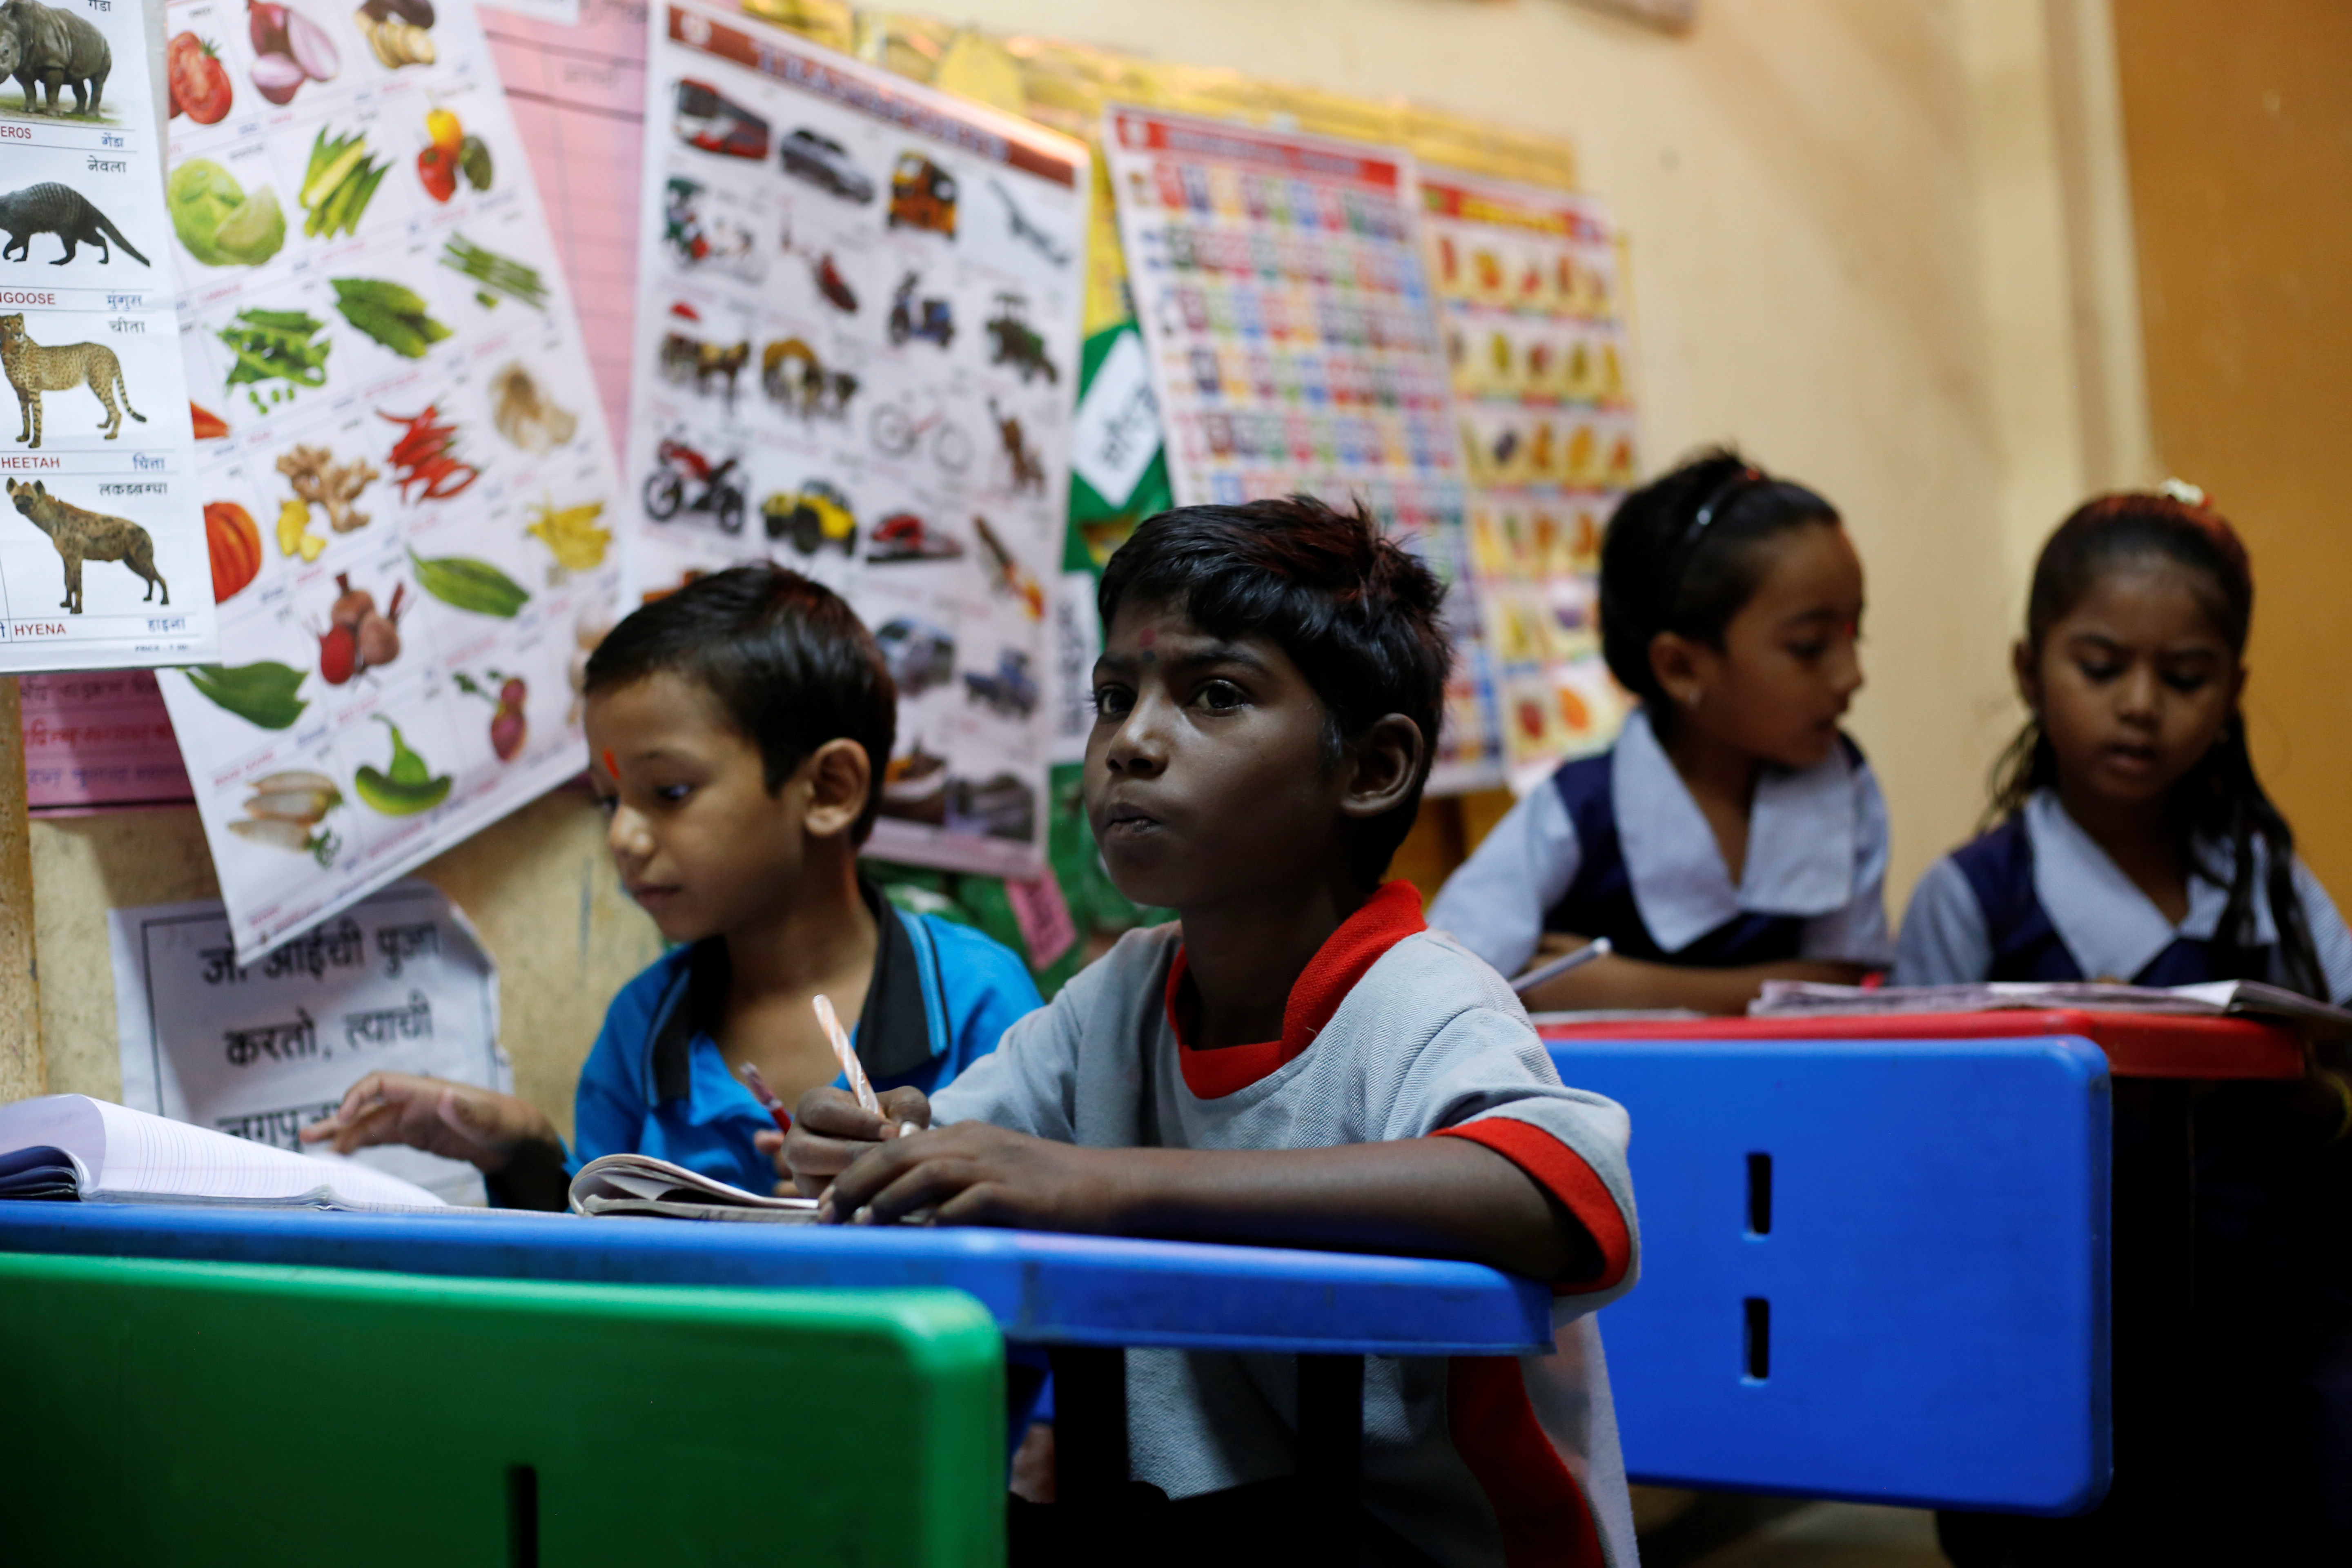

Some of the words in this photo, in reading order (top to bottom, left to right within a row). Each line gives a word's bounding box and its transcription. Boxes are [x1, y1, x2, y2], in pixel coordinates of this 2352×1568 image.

[87, 155, 127, 173] नेवला
[0, 292, 56, 305] GOOSE
[108, 317, 145, 333] चीता
[2, 457, 60, 469] HEETAH
[15, 624, 66, 636] HYENA
[344, 988, 434, 1052] त्याची
